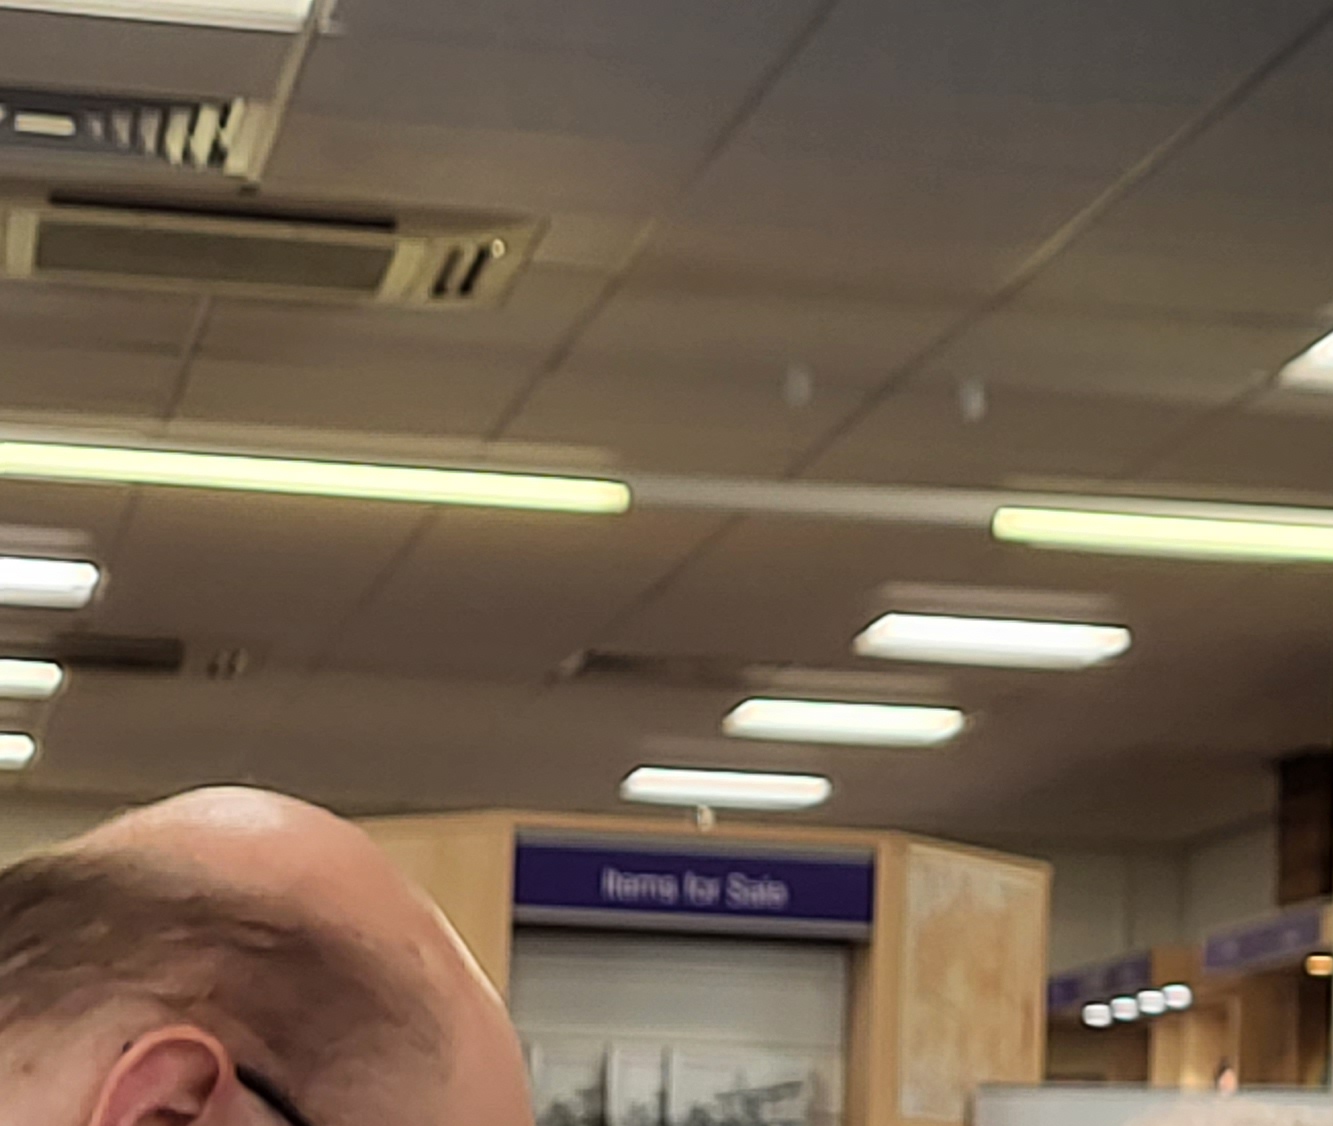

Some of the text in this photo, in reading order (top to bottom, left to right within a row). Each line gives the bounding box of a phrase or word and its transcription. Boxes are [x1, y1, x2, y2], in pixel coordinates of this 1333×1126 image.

[602, 867, 790, 910] Items for Sale
